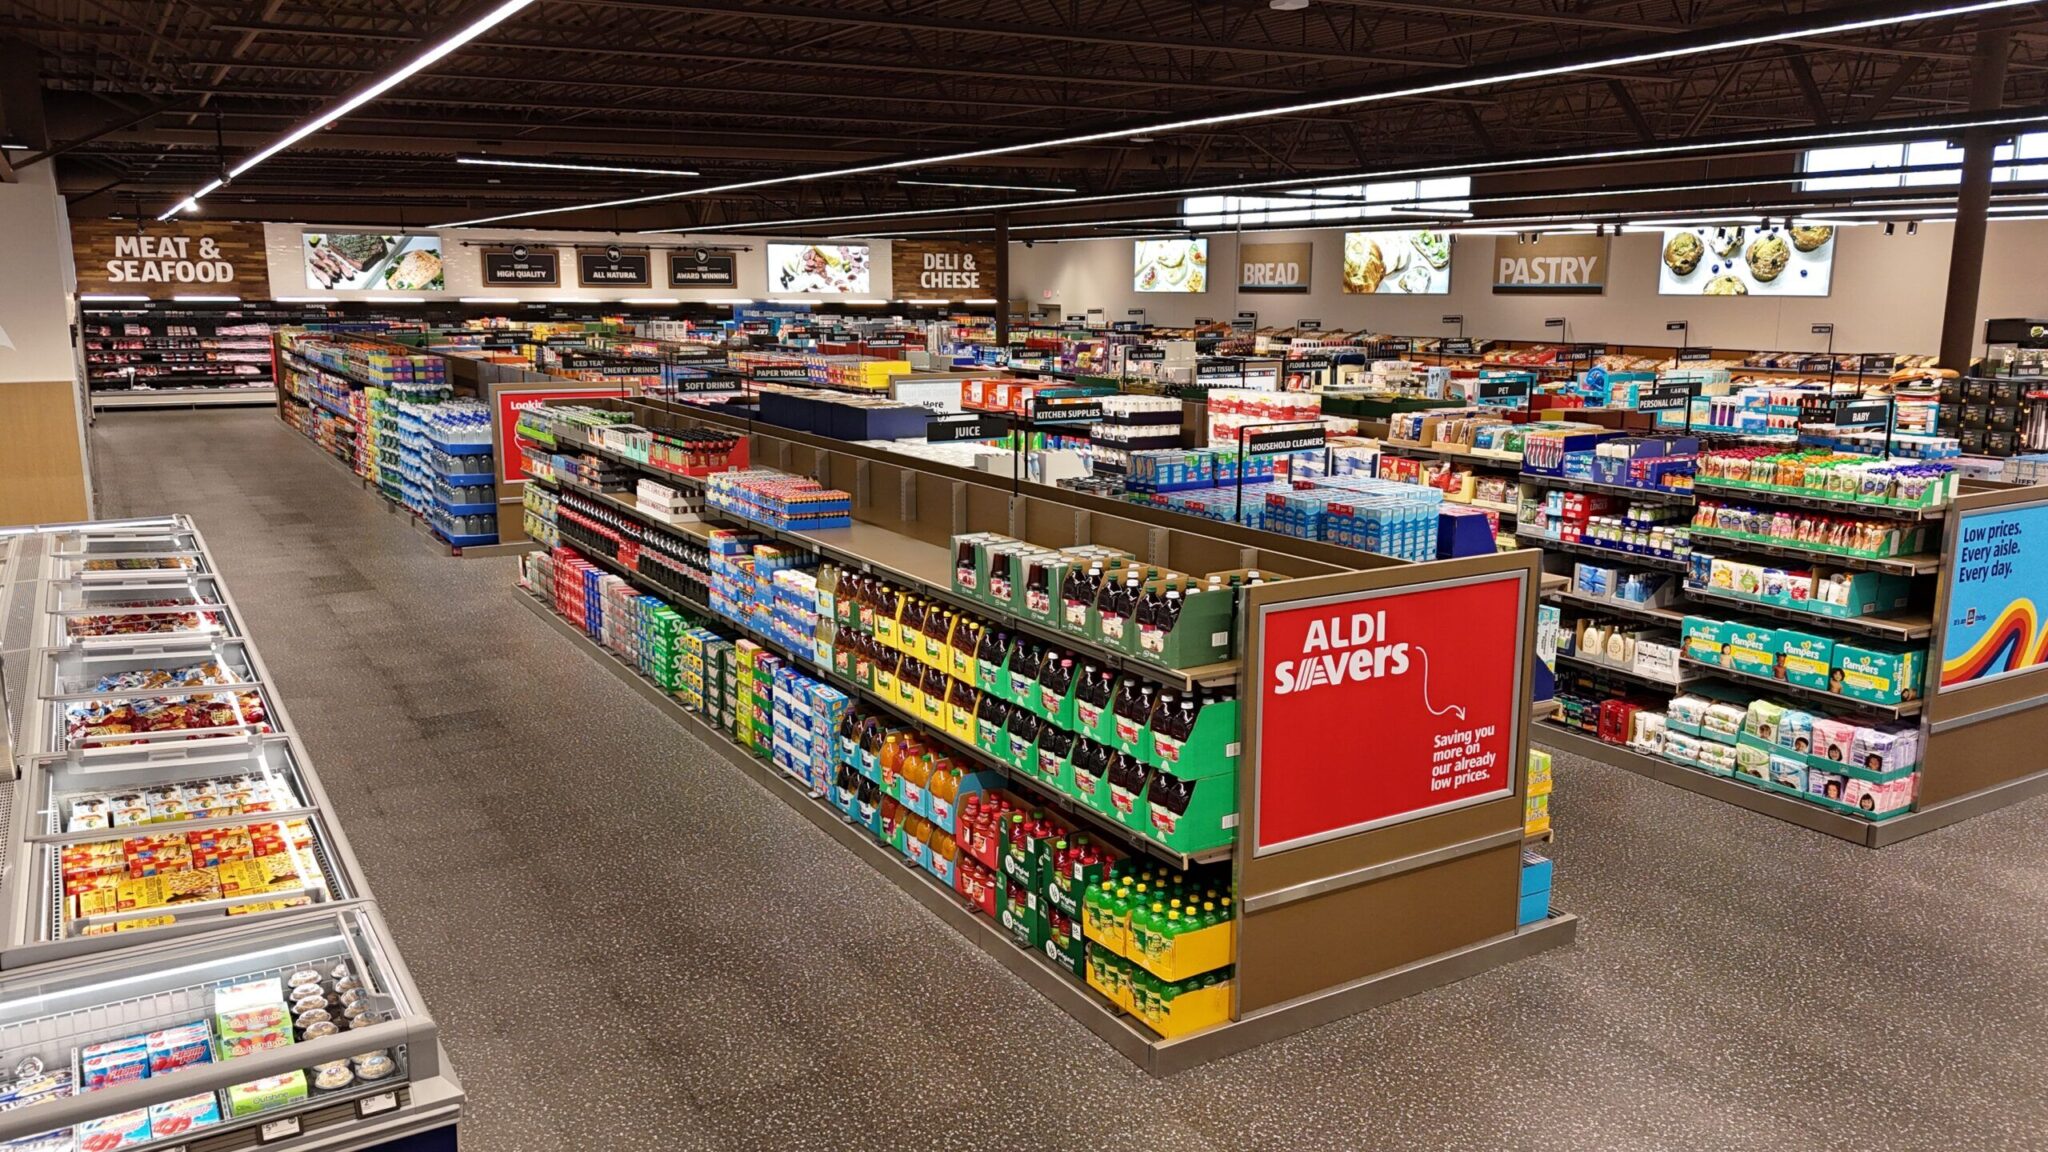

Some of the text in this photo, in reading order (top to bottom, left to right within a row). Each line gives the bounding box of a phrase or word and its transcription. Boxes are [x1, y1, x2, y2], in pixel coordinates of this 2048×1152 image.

[115, 236, 221, 260] MEAT &
[924, 253, 976, 270] DELI &
[107, 260, 234, 283] SEAFOOD
[516, 271, 546, 279] QUALITY
[1243, 262, 1299, 285] BREAD
[1500, 257, 1598, 285] PASTRY
[921, 272, 980, 288] CHEESE
[757, 369, 805, 377] PAPER TOWELS
[685, 381, 735, 390] SOFT DRINKS
[1498, 386, 1509, 395] PET
[1640, 398, 1684, 409] PERSONAL CARE
[1037, 408, 1100, 419] KITCHEN SUPPLIES
[1852, 412, 1869, 421] BABY
[955, 426, 981, 439] JUICE
[1251, 437, 1324, 452] HOUSEHOLD CLEANERS
[1964, 520, 2022, 543] Low prices.
[1961, 539, 2020, 564] Every aisle.
[1959, 560, 2012, 583] Every day.
[1303, 610, 1386, 653] ALDI
[1690, 627, 1715, 641] Pampers
[1731, 633, 1763, 650] Pampers
[1784, 642, 1819, 659] Pampers
[1843, 656, 1878, 675] Pampers
[1433, 725, 1495, 748] Saving you
[1433, 743, 1480, 762] more on
[1432, 751, 1496, 777] our already
[1431, 769, 1490, 791] low prices.
[252, 1092, 289, 1104] Outshine
